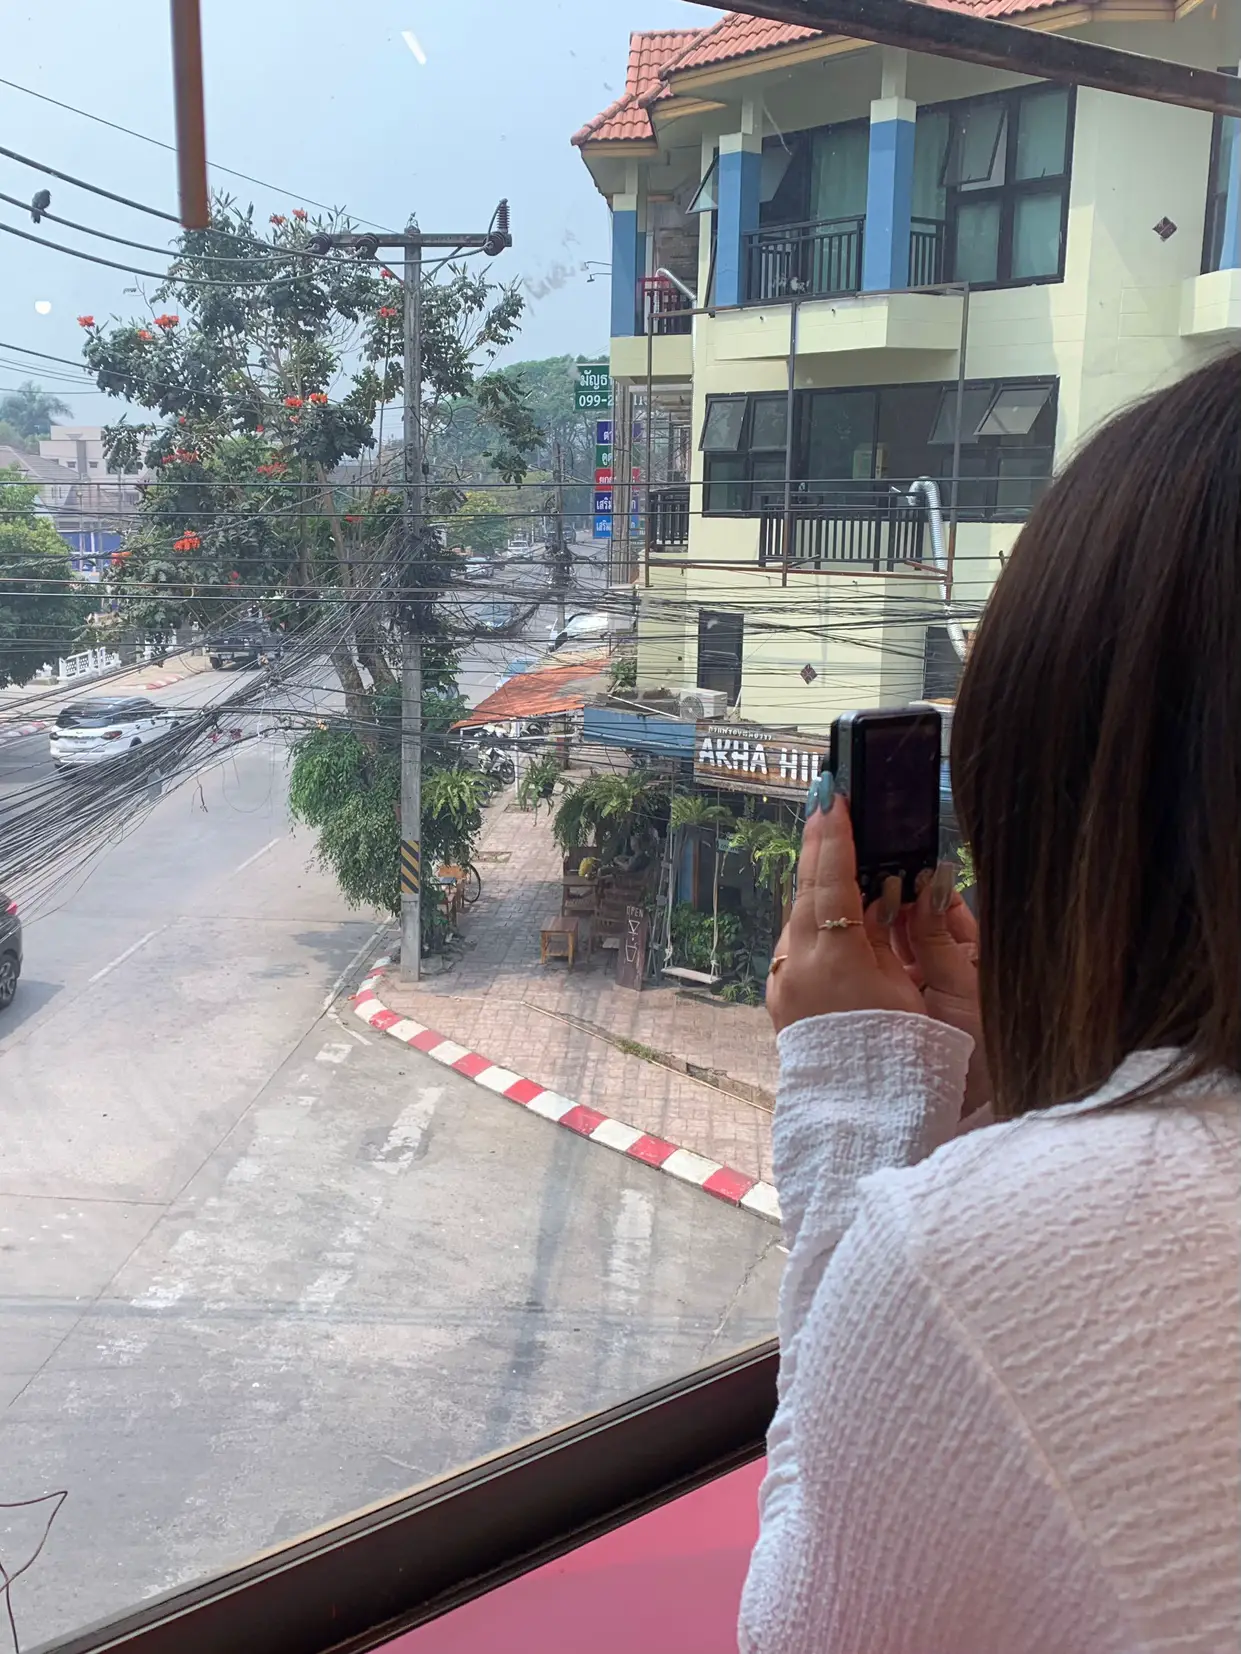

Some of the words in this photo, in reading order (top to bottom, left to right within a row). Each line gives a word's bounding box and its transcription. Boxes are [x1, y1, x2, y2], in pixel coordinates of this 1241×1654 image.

[578, 394, 614, 407] 099-2
[699, 738, 767, 774] AKHA
[626, 905, 643, 918] OPEN
